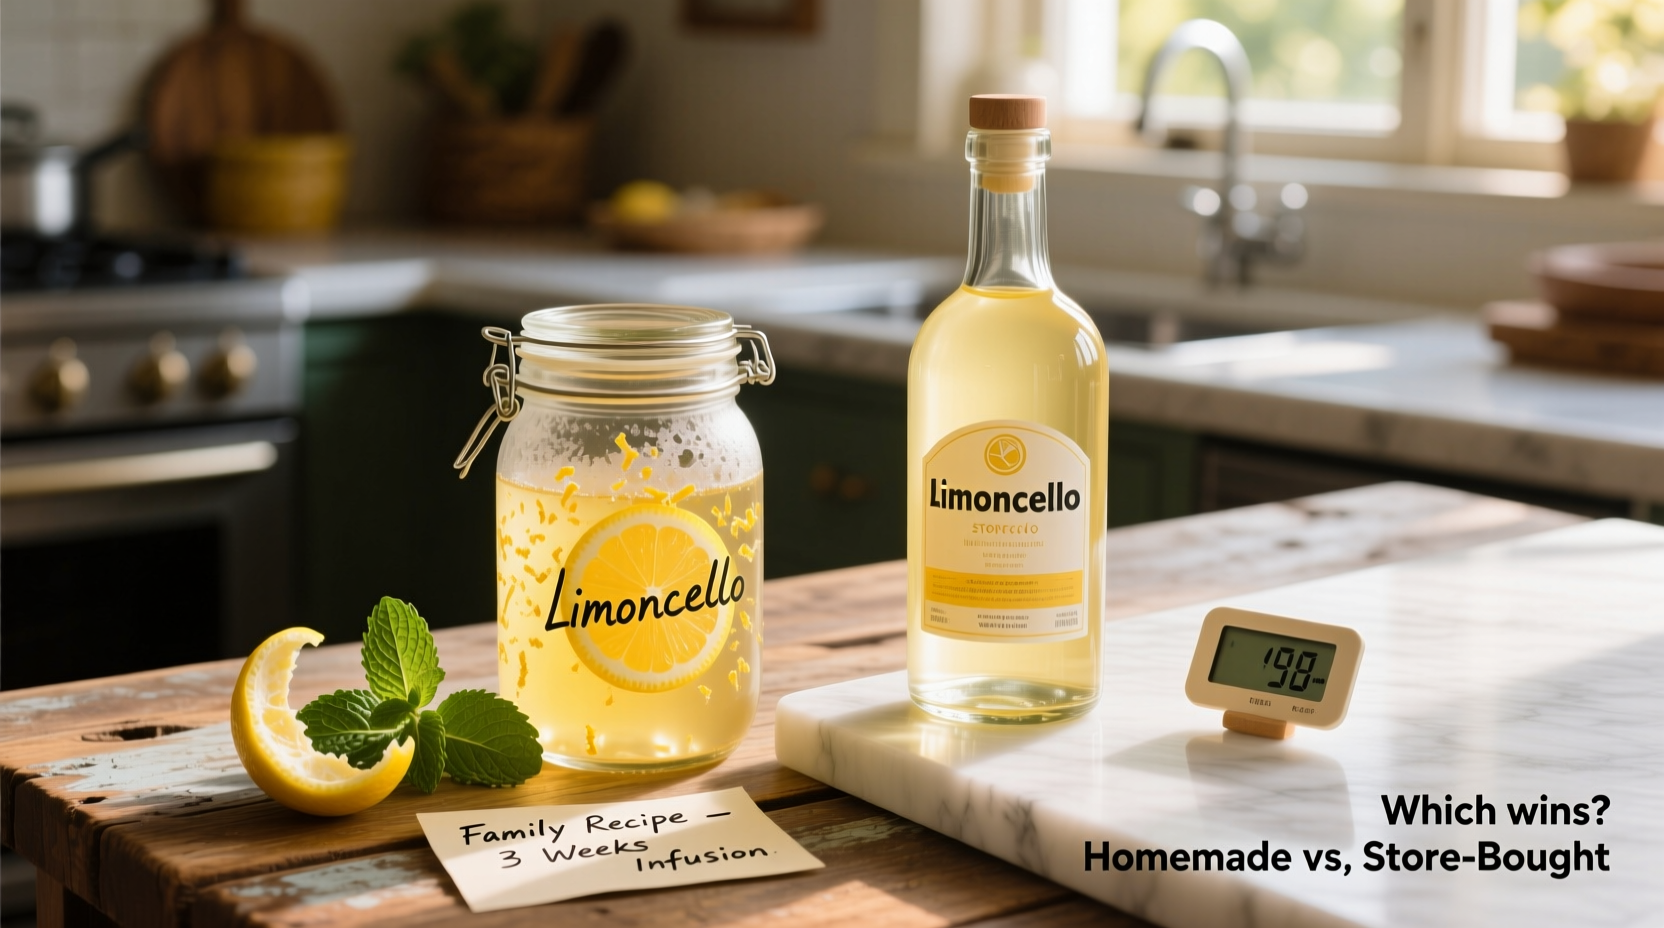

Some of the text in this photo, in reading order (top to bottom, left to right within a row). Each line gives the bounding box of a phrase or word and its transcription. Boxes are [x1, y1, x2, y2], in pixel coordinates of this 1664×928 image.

[930, 478, 1081, 513] Limoncello
[544, 556, 745, 632] Limoncello
[459, 819, 565, 846] Family
[586, 812, 688, 834] Recipe
[499, 839, 649, 869] 3 Weeks
